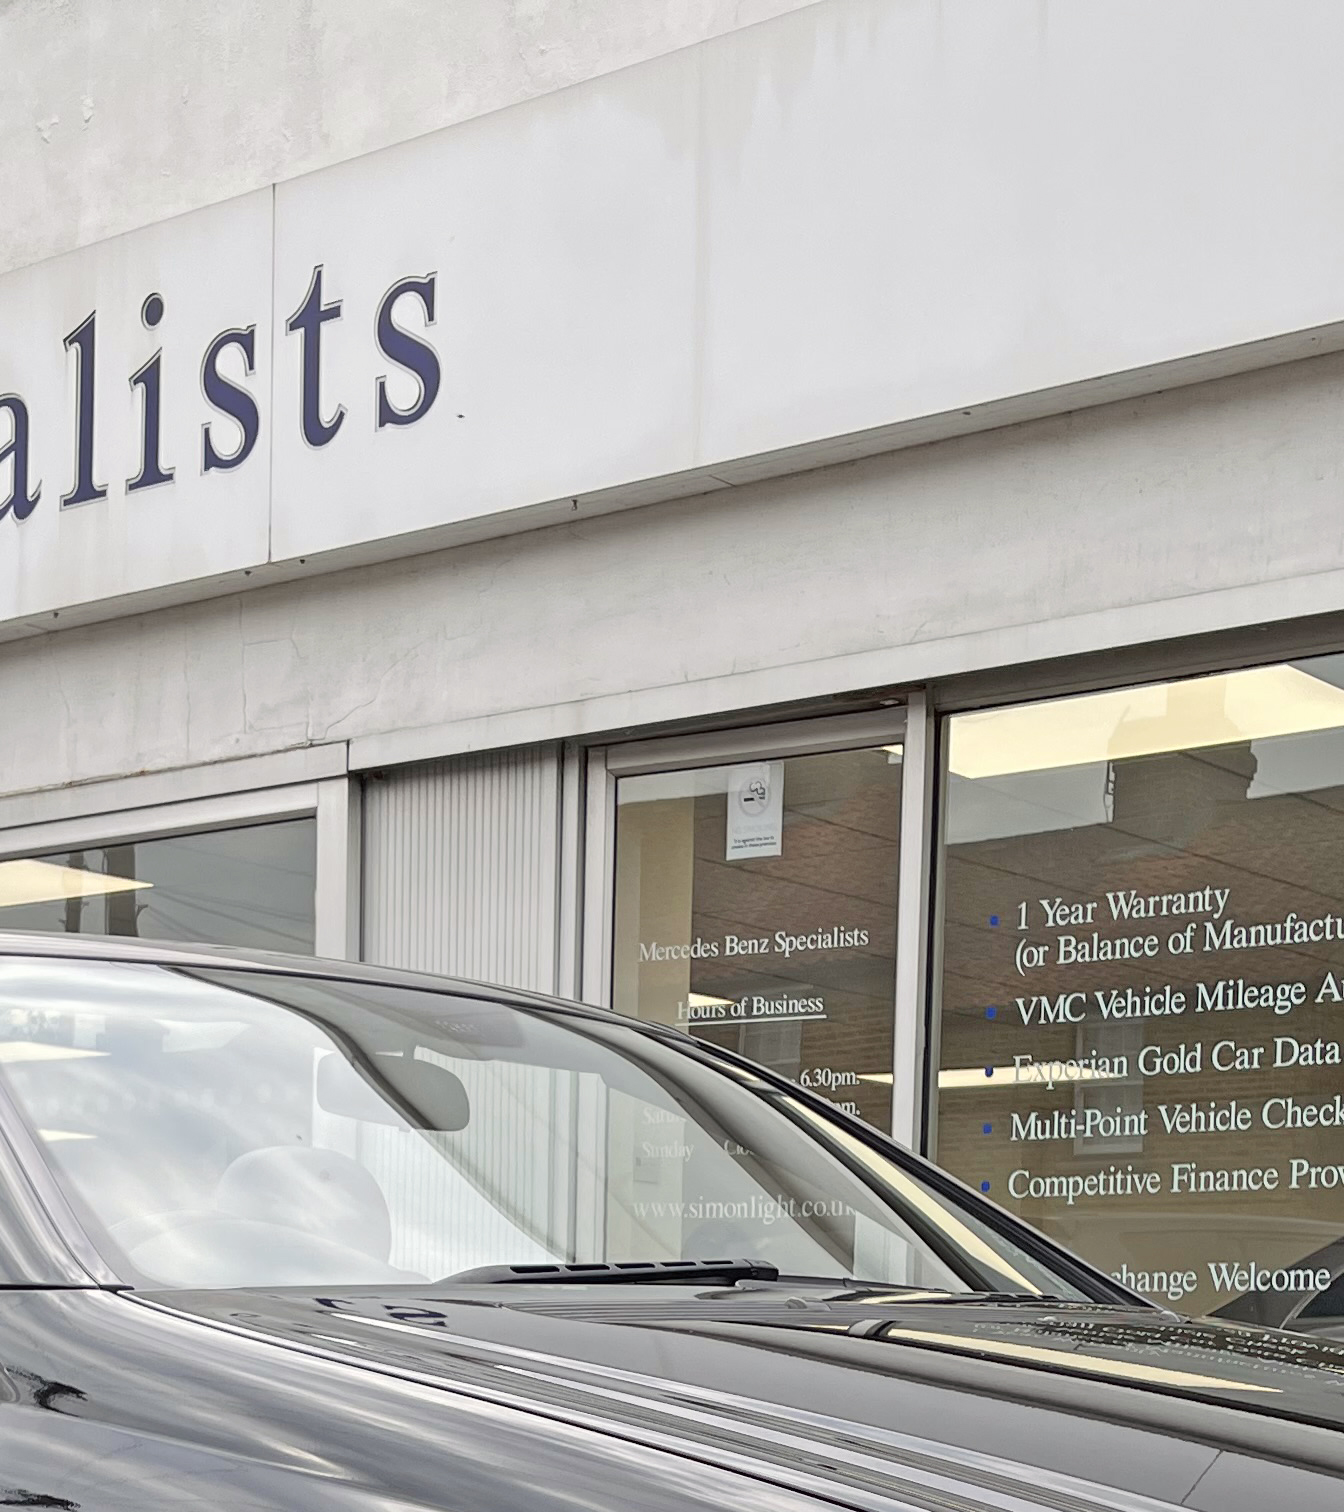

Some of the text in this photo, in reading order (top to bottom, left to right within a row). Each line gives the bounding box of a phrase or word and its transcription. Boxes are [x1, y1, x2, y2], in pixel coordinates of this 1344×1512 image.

[1017, 885, 1231, 930] 1 Year Warranty
[639, 926, 869, 963] Mercedes Benz Specialists
[1015, 937, 1049, 977] (or
[1056, 932, 1159, 966] Balance
[1167, 922, 1195, 954] of
[677, 994, 824, 1020] Hours of Business
[1015, 993, 1086, 1026] VMC
[1094, 984, 1186, 1019] Vehicle
[1195, 978, 1306, 1016] Mileage
[800, 1067, 861, 1091] 6.30pm.
[1012, 1051, 1128, 1090] Experian
[1138, 1044, 1201, 1077] Gold
[1211, 1040, 1264, 1071] Car
[1273, 1035, 1342, 1067] Data
[1009, 1106, 1148, 1142] Multi-Point
[1158, 1101, 1252, 1134] Vehicle
[641, 1139, 694, 1162] Sunday
[1008, 1162, 1161, 1205] Competitive
[1170, 1159, 1279, 1194] Finance
[1207, 1262, 1332, 1294] Welcome
